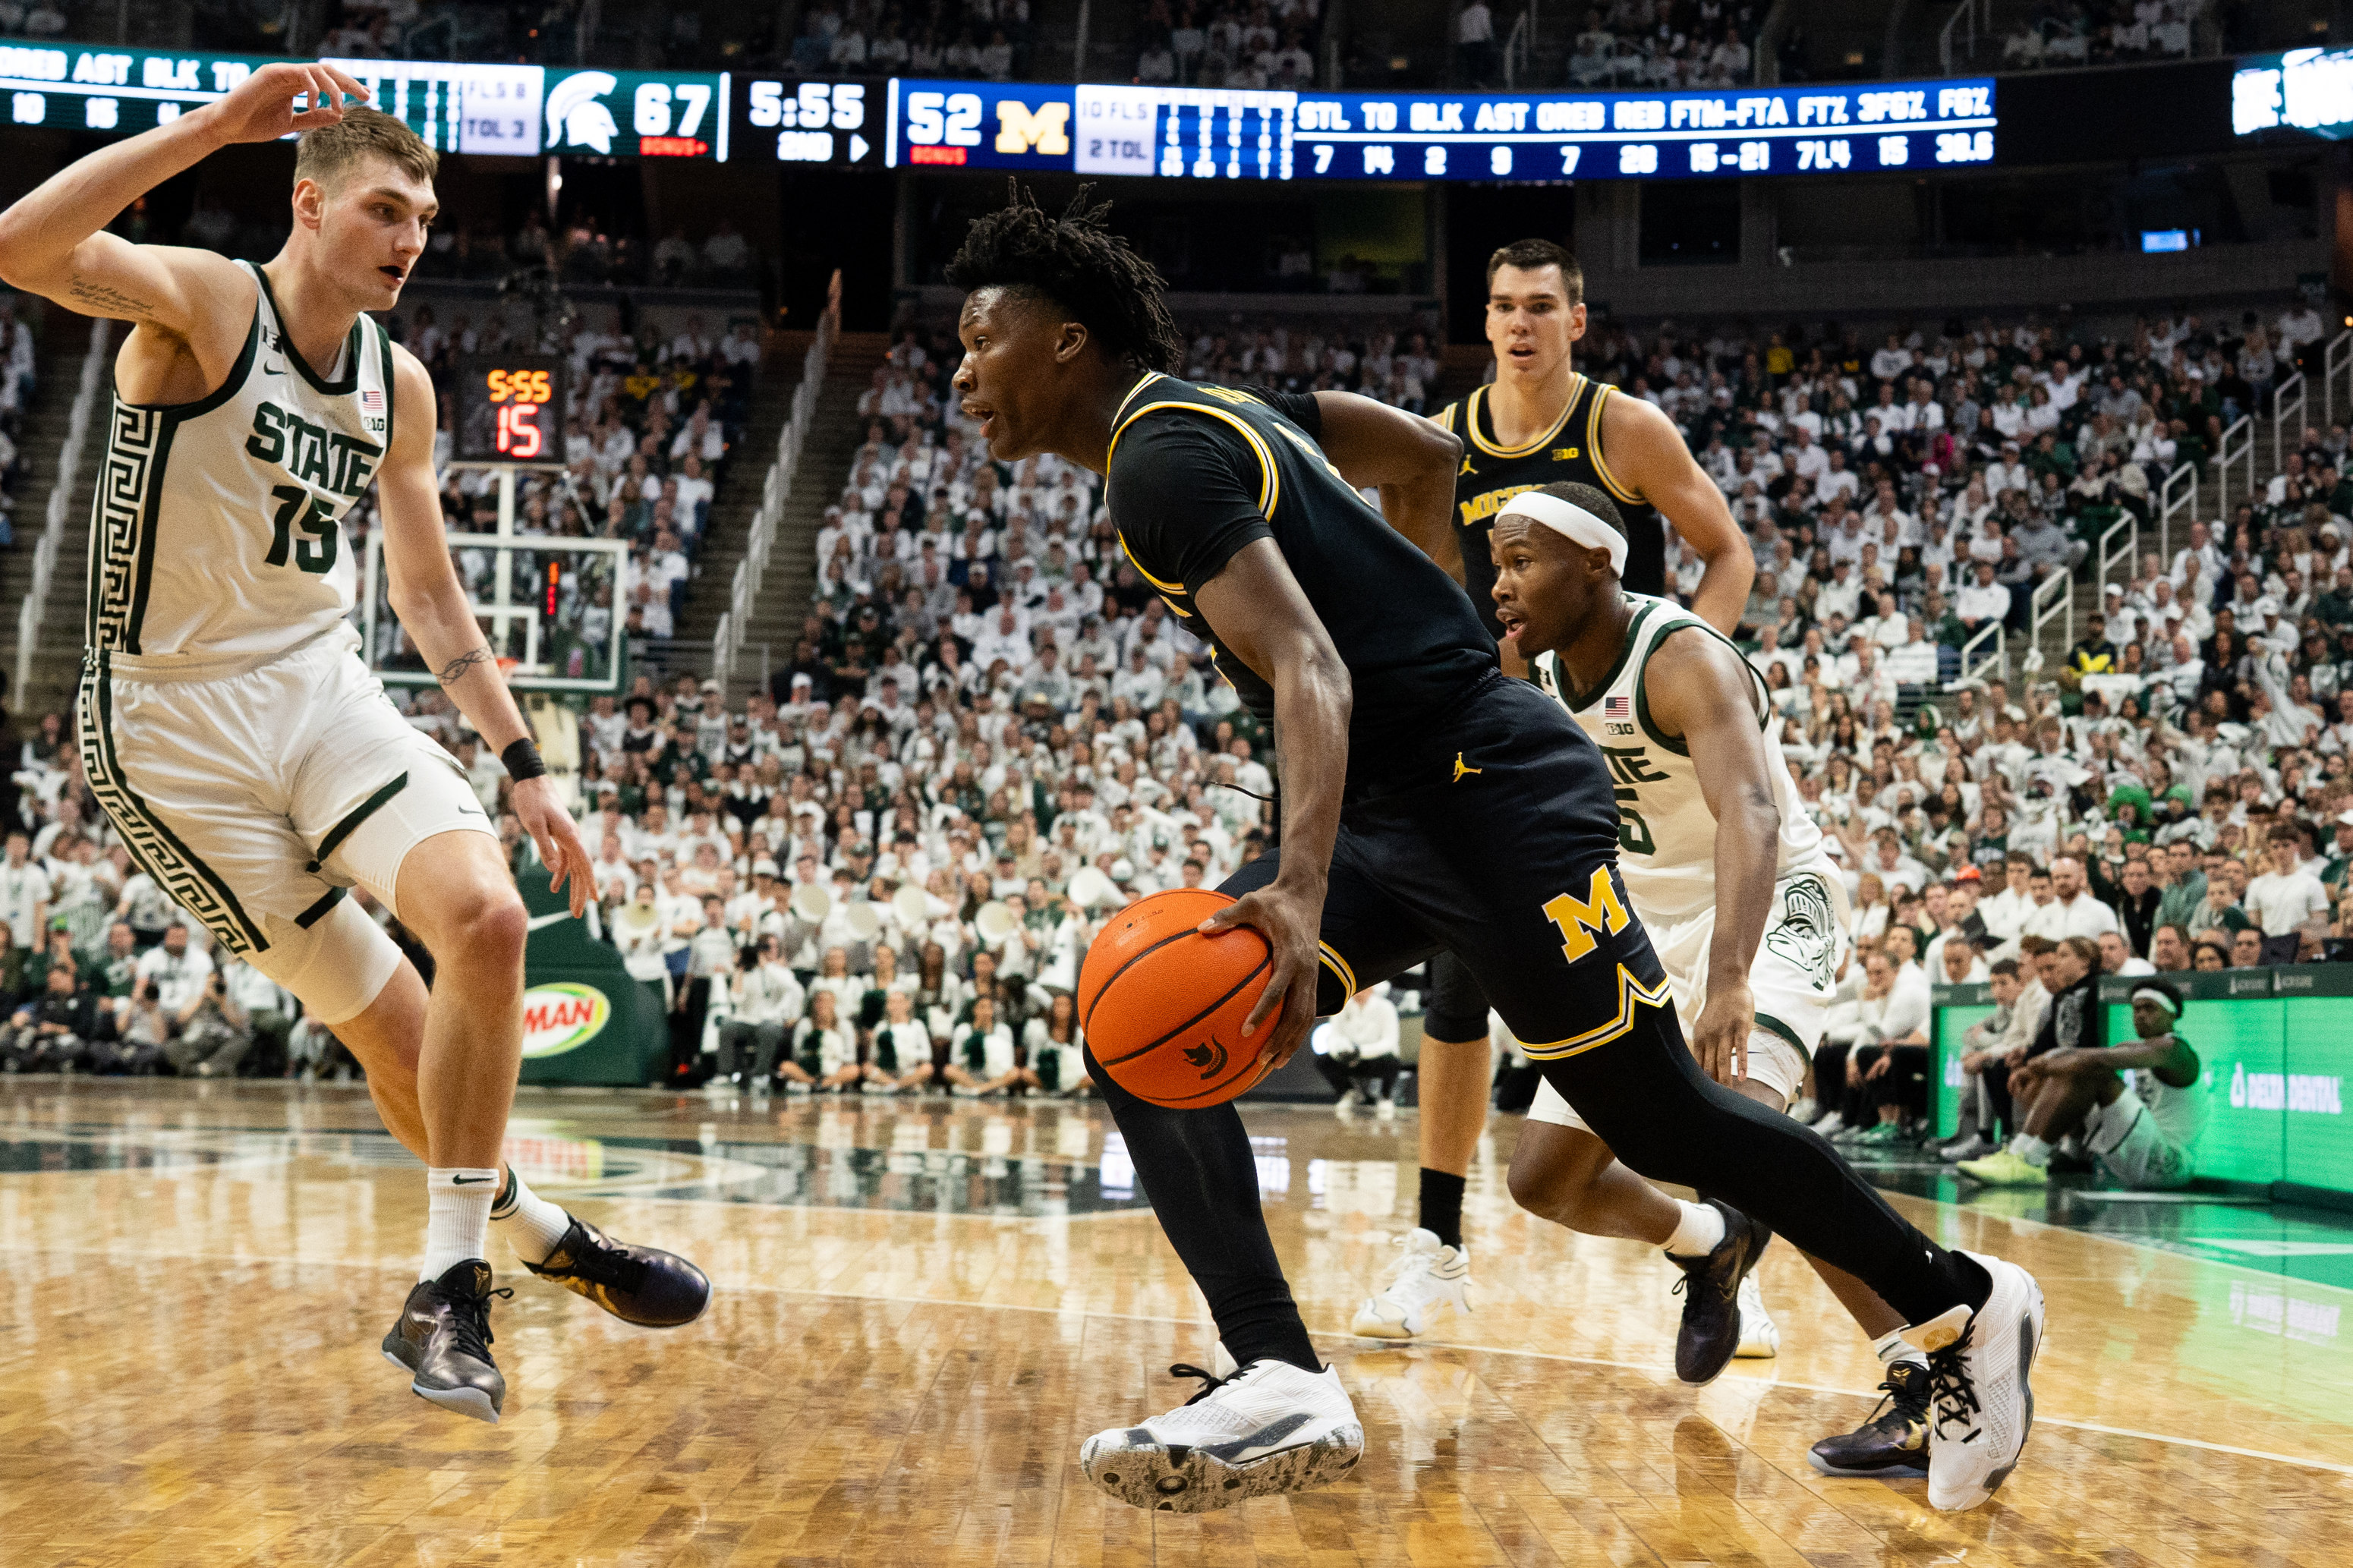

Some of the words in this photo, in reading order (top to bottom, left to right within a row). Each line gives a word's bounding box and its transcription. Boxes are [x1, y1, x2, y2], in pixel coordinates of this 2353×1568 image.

[72, 52, 134, 85] AST
[143, 57, 200, 90] BLK
[634, 83, 711, 137] 67
[749, 80, 865, 129] 5:55
[907, 92, 982, 146] 52
[1110, 102, 1148, 120] FLS
[1297, 101, 1351, 131] STL
[1360, 102, 1397, 131] TO
[1410, 102, 1463, 131] BLK
[1474, 102, 1530, 131] AST
[1536, 102, 1605, 131] OREB
[1614, 100, 1665, 130] REB
[1671, 96, 1789, 128] FTM-FTA
[1797, 96, 1849, 125] FT%
[1857, 90, 1927, 122] 3FG%
[1939, 87, 1992, 118] FG%
[467, 118, 504, 139] TOL
[995, 100, 1070, 155] M
[1089, 139, 1103, 158] 2
[1107, 139, 1148, 159] TOL
[1312, 145, 1334, 174] 7
[1363, 146, 1394, 175] 14
[1425, 146, 1447, 175] 2
[1560, 145, 1580, 175] 7
[1690, 141, 1769, 172] 15-21
[1796, 139, 1851, 169] 71.4
[1879, 136, 1908, 165] 15
[487, 370, 552, 403] 5:55
[245, 401, 384, 497] STATE
[496, 404, 541, 457] 15
[1541, 863, 1631, 965] M
[2247, 1072, 2285, 1110] DELTA
[2288, 1074, 2342, 1114] DENTAL
